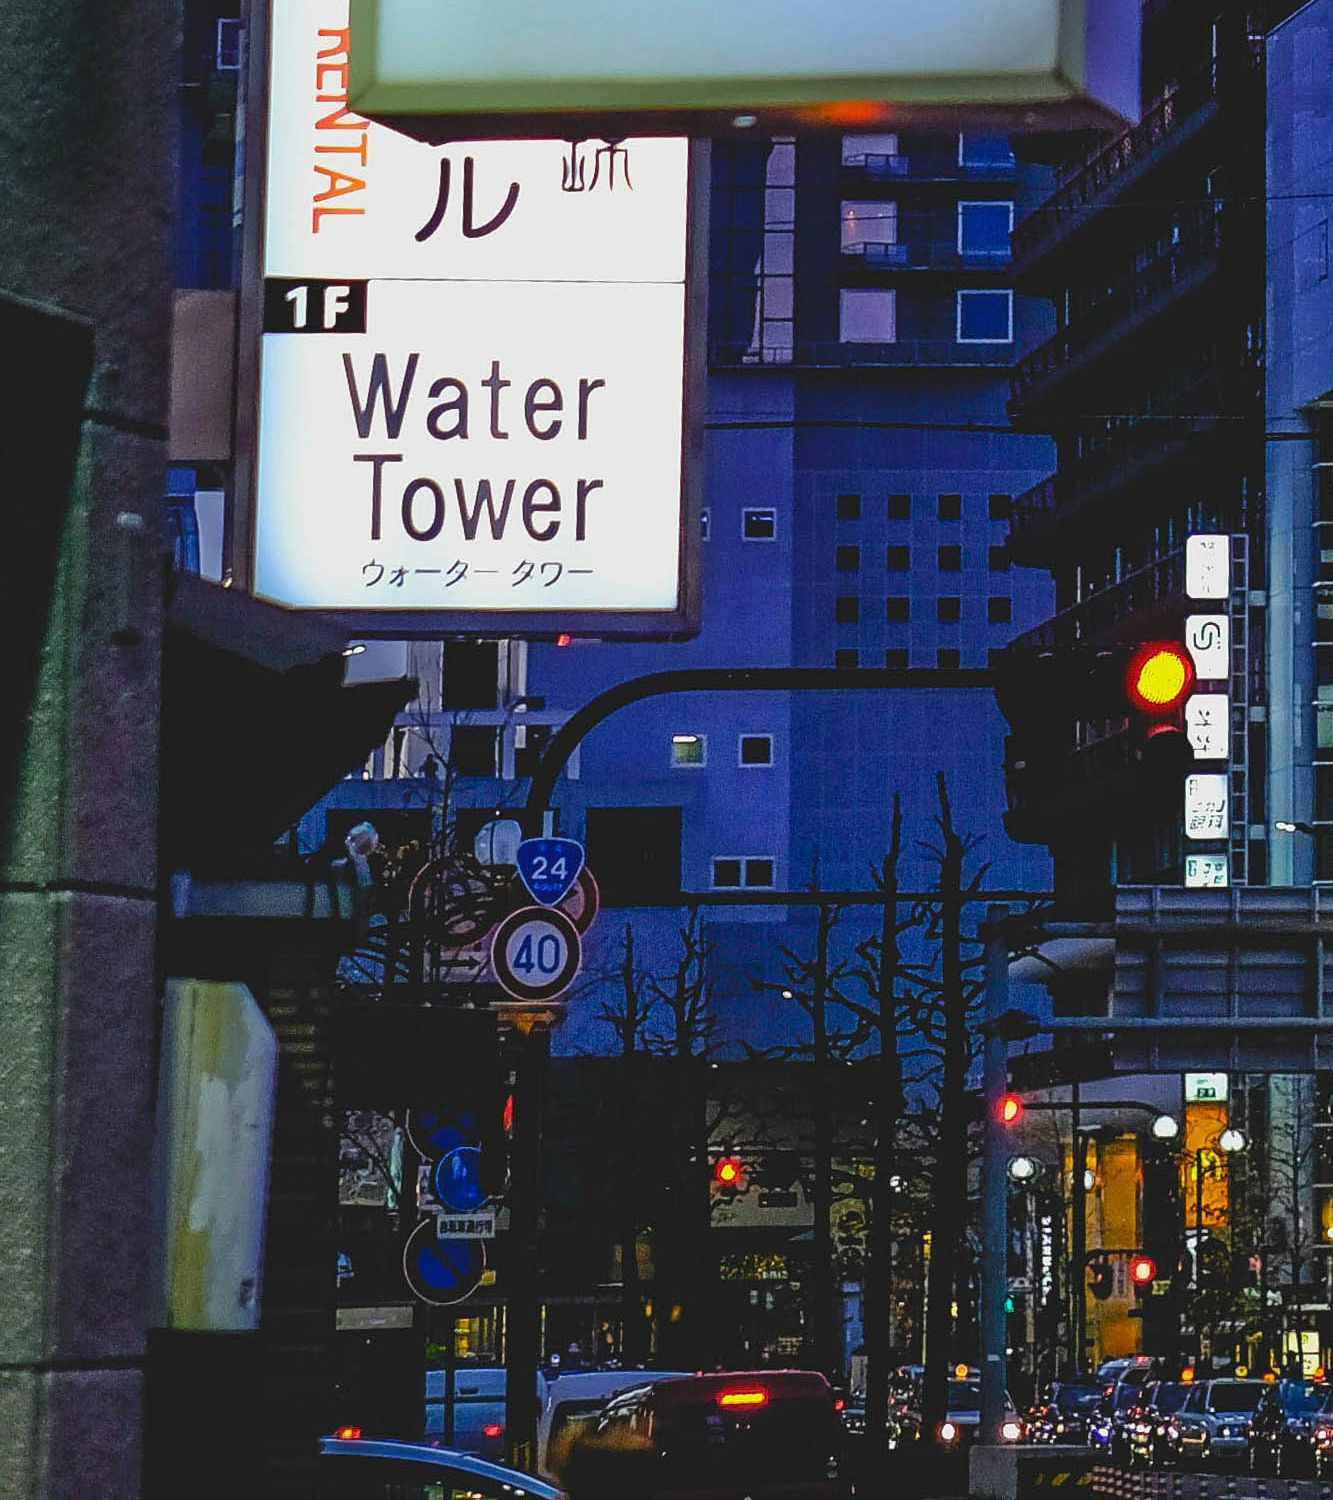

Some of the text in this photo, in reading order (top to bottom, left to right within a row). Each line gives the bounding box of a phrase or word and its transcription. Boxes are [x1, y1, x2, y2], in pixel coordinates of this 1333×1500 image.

[312, 27, 371, 235] RENTAL
[285, 285, 350, 329] 1F
[341, 352, 606, 441] Water
[352, 453, 604, 542] Tower
[362, 558, 594, 588] ウォーター タワー
[531, 855, 568, 881] 24
[513, 934, 561, 974] 40
